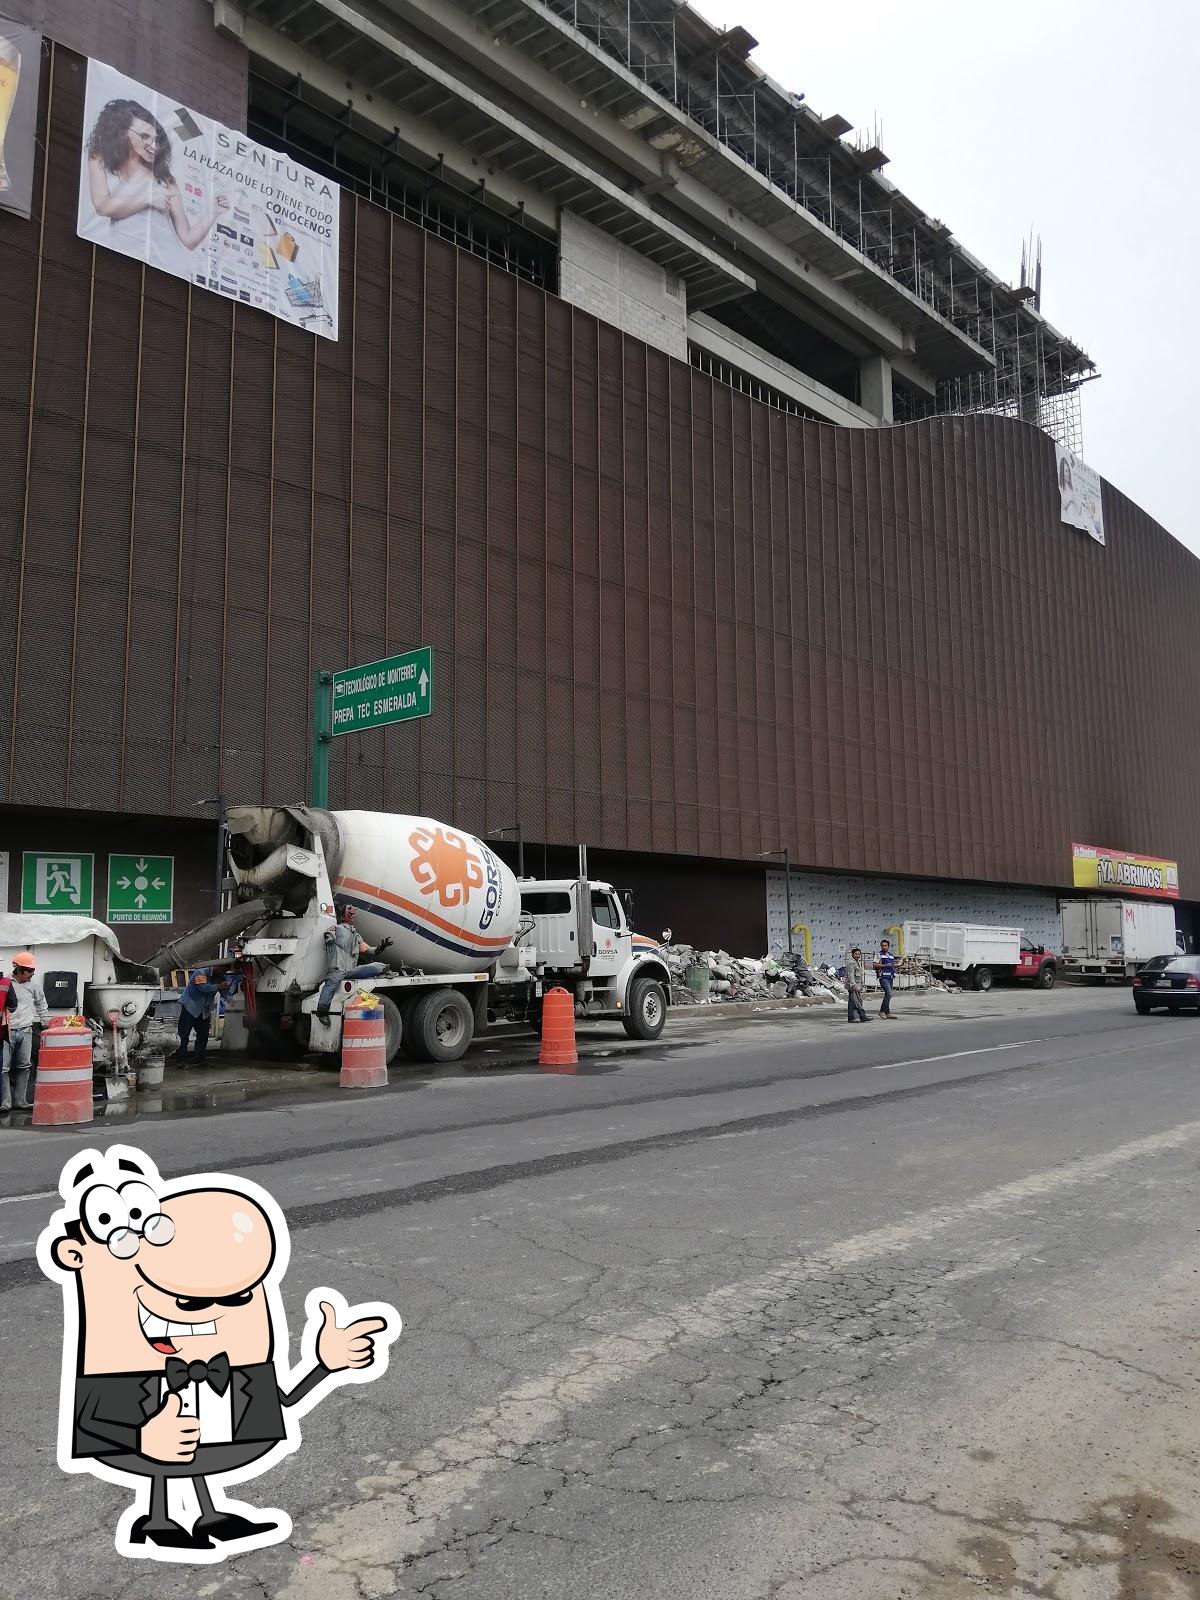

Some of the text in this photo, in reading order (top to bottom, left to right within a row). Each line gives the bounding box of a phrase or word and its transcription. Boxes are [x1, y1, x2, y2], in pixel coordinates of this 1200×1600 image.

[217, 132, 333, 199] SENTURA
[184, 146, 197, 161] LA
[200, 154, 233, 179] PLAZA
[235, 172, 258, 190] QUE
[260, 183, 274, 197] LO
[276, 189, 304, 211] TIENE
[304, 204, 333, 225] TODO
[266, 201, 333, 238] CONÓCENOS
[345, 663, 418, 696] TECNOLÓGICO DE MONTERREY
[334, 692, 417, 724] PREPA TEC ESMERALDA
[472, 837, 498, 930] GORSA
[1117, 862, 1163, 889] ABRIMOS!
[112, 912, 167, 921] PUNTO DE REUNIÓN
